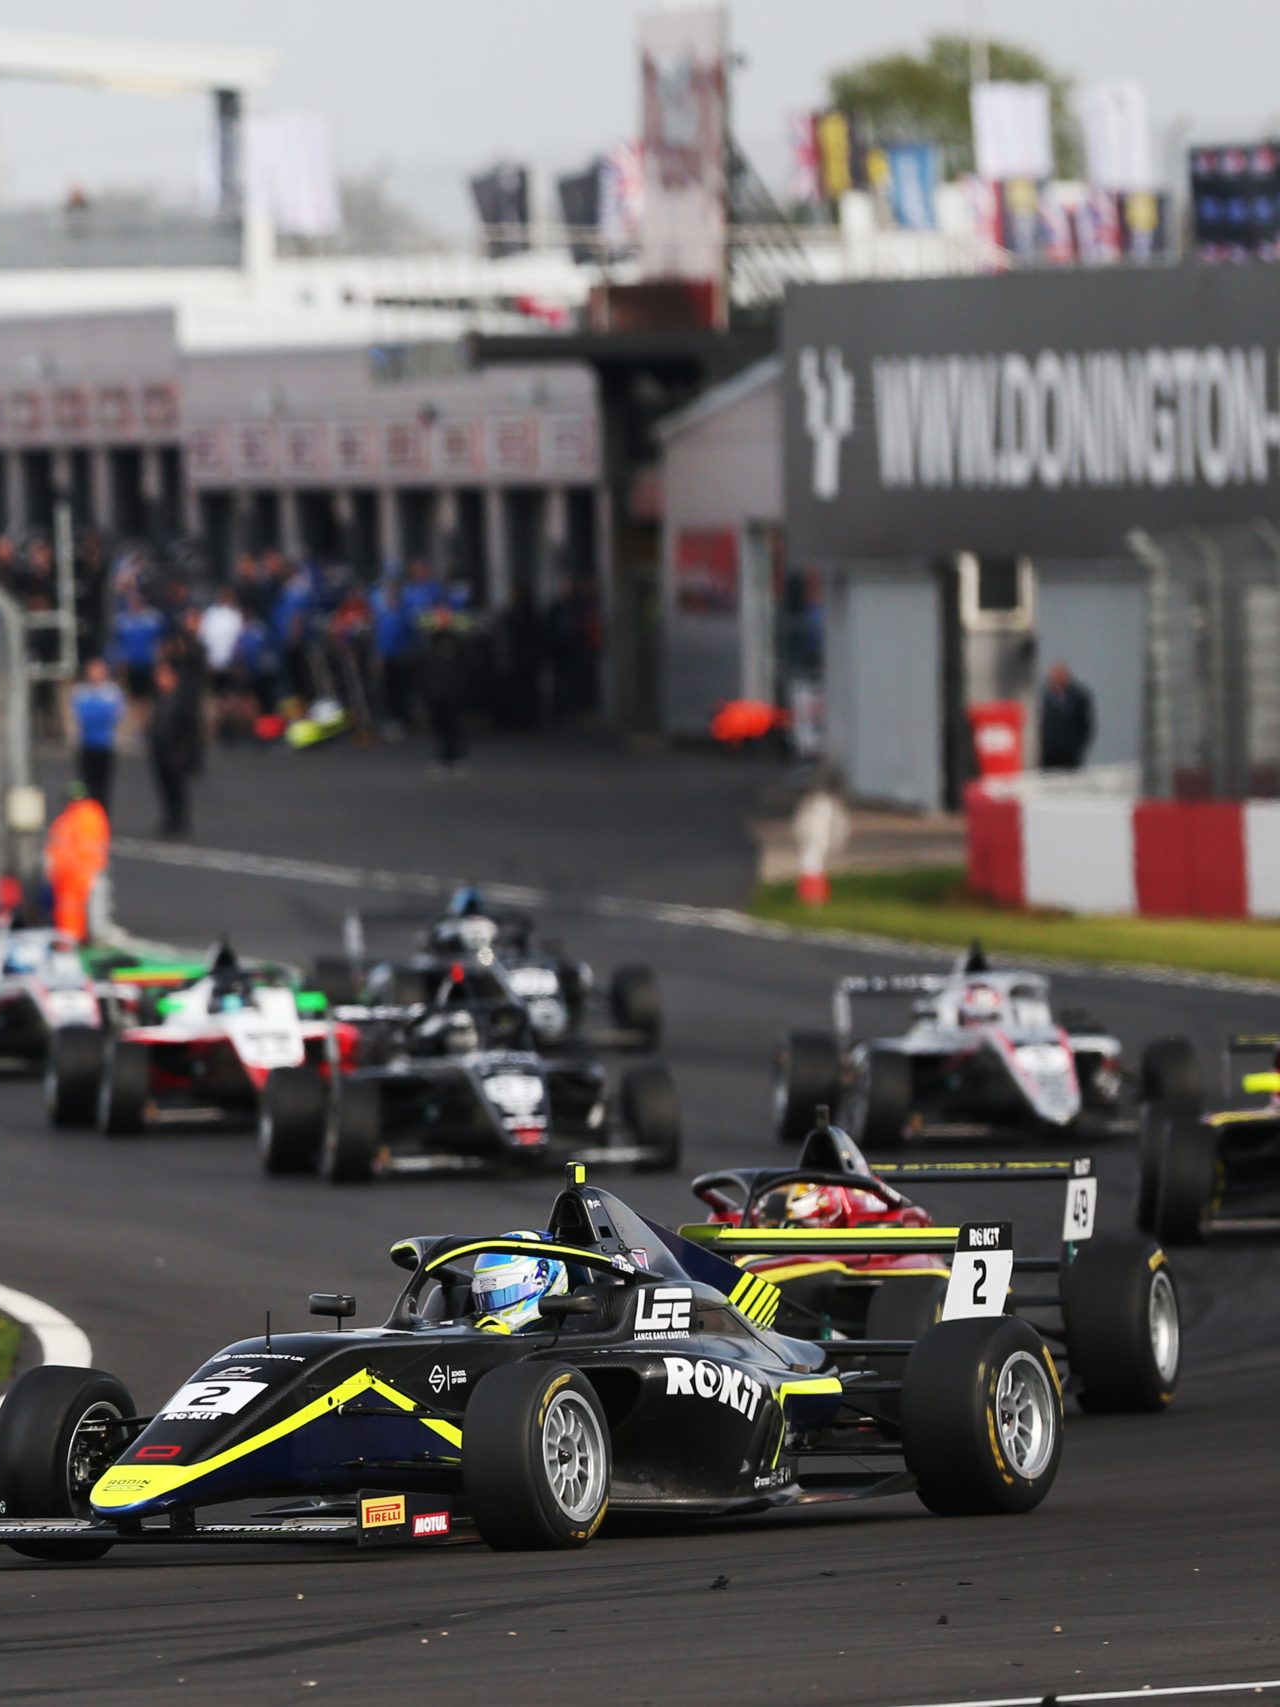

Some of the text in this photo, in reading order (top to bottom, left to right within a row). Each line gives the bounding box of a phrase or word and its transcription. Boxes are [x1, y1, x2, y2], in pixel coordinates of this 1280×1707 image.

[972, 1259, 987, 1305] 2
[634, 1332, 652, 1341] LANCE
[653, 1331, 667, 1340] EAST
[187, 1386, 231, 1406] 2
[365, 1503, 401, 1524] PIRELLI
[414, 1515, 448, 1534] MOTUL
